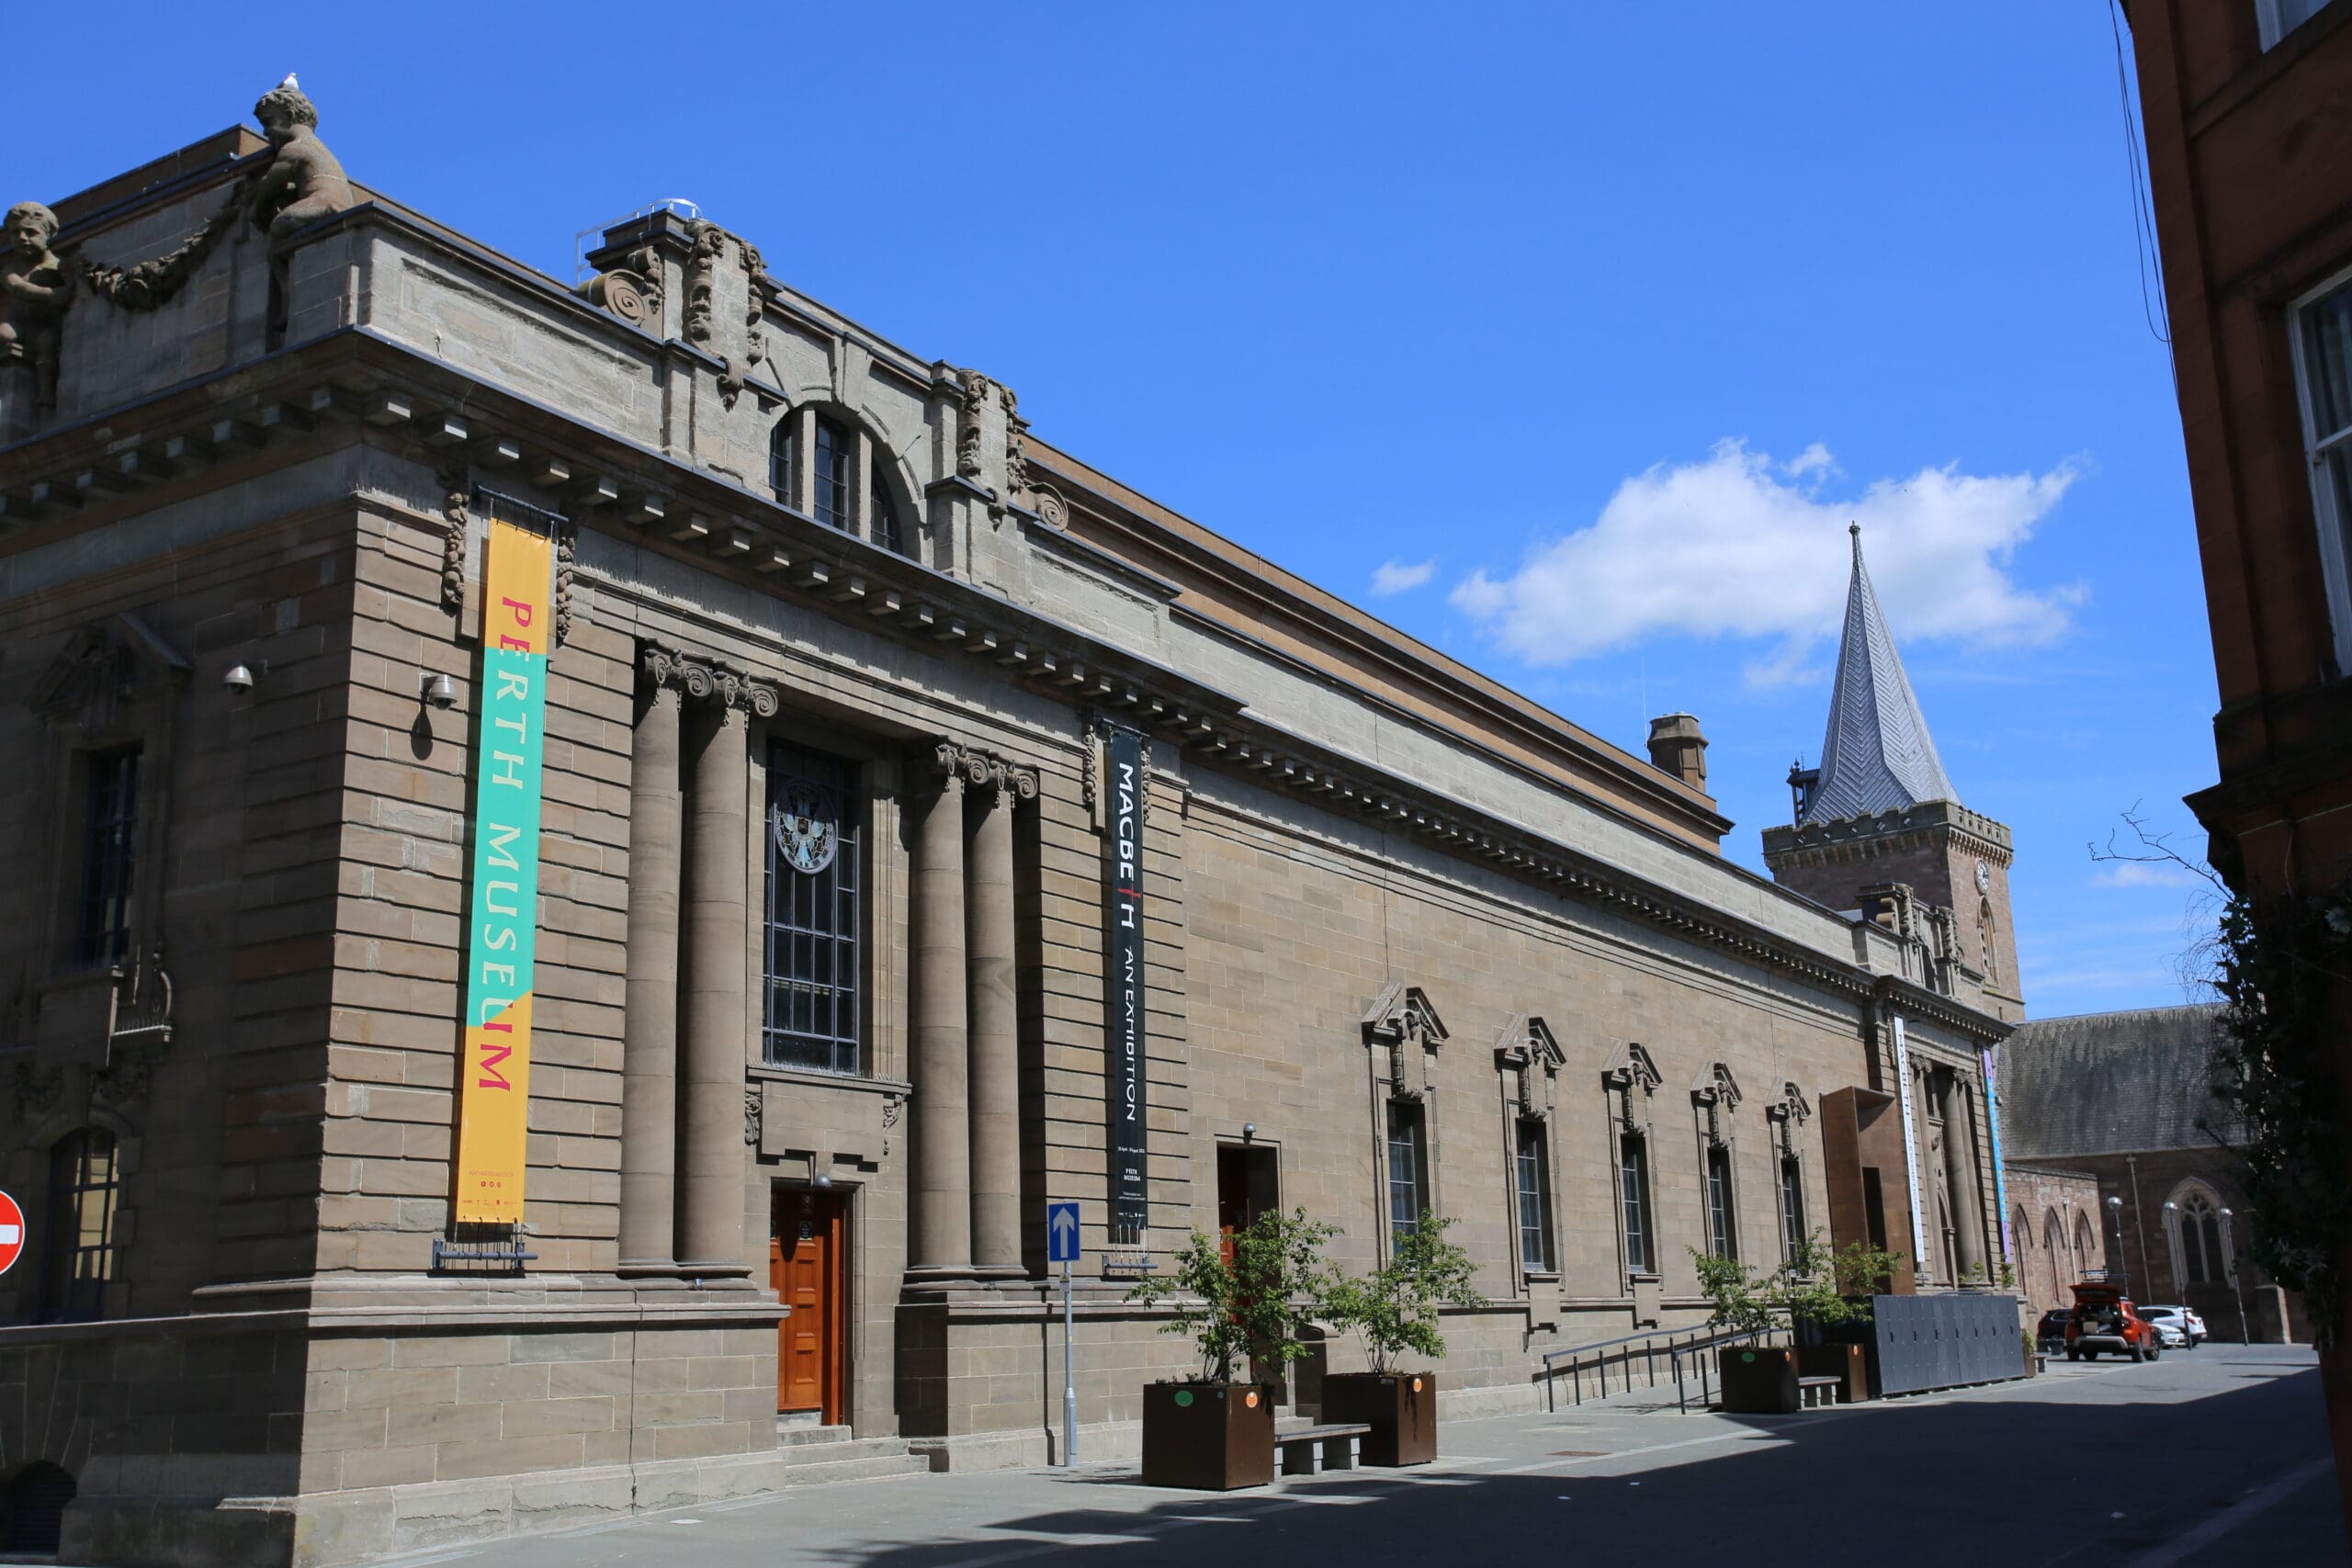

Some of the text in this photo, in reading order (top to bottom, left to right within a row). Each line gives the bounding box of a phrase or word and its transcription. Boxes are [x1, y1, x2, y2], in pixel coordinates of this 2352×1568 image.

[479, 596, 533, 1092] PERTH MUSEUM
[1125, 945, 1135, 982] AN
[1125, 987, 1136, 1122] EXHIBITION
